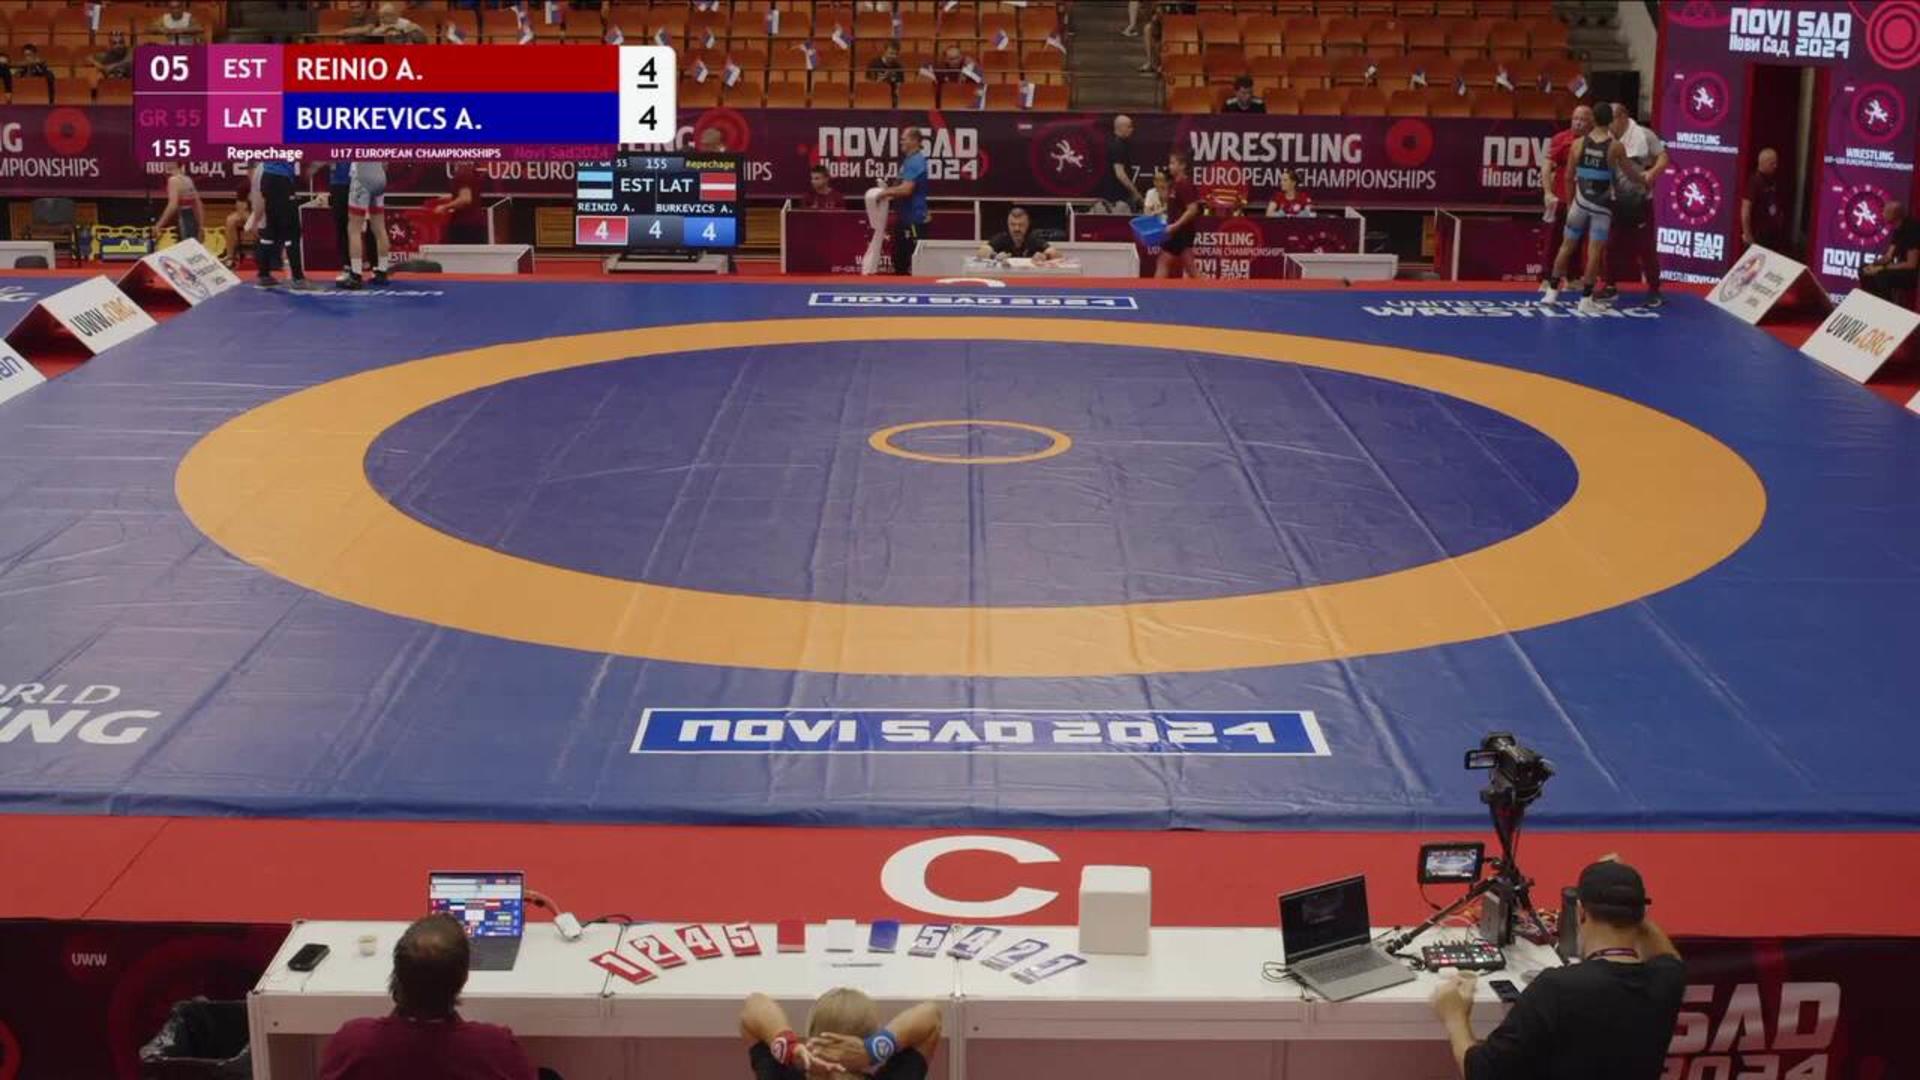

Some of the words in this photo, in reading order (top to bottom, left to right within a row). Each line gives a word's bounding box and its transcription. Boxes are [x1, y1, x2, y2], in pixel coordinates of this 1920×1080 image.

[1730, 7, 1791, 36] NOVI
[1797, 11, 1852, 39] SAD
[1762, 36, 1790, 58] Сад
[1795, 38, 1850, 59] 2024
[818, 127, 898, 157] NOVI
[1190, 131, 1362, 163] WRESTLING
[1483, 136, 1551, 166] NOV
[527, 161, 575, 180] EURO
[645, 159, 668, 169] 155
[927, 159, 978, 180] 024
[620, 178, 654, 193] EST
[660, 179, 694, 193] LAT
[1193, 167, 1283, 187] EUROPEAN
[577, 203, 617, 211] REINIO
[622, 203, 635, 212] A.
[656, 203, 715, 213] BURKEVICS
[720, 205, 733, 213] A.
[595, 221, 609, 239] 4
[649, 220, 662, 239] 4
[702, 222, 716, 241] 4
[1193, 232, 1254, 246] RESTLING
[1694, 232, 1724, 250] SAD
[1693, 247, 1723, 261] 2024
[1823, 248, 1860, 268] NOVI
[0, 682, 121, 704] RLD
[678, 719, 856, 742] NOVI
[881, 720, 1034, 743] SAD
[1052, 720, 1276, 744] 2024
[881, 835, 1061, 918] C
[684, 926, 714, 950] 4
[725, 924, 755, 949] 5
[916, 925, 949, 950] 5
[955, 927, 998, 953] 4
[72, 952, 107, 967] UWW
[632, 938, 676, 961] 2
[993, 942, 1043, 965] 2
[600, 953, 643, 975] 1
